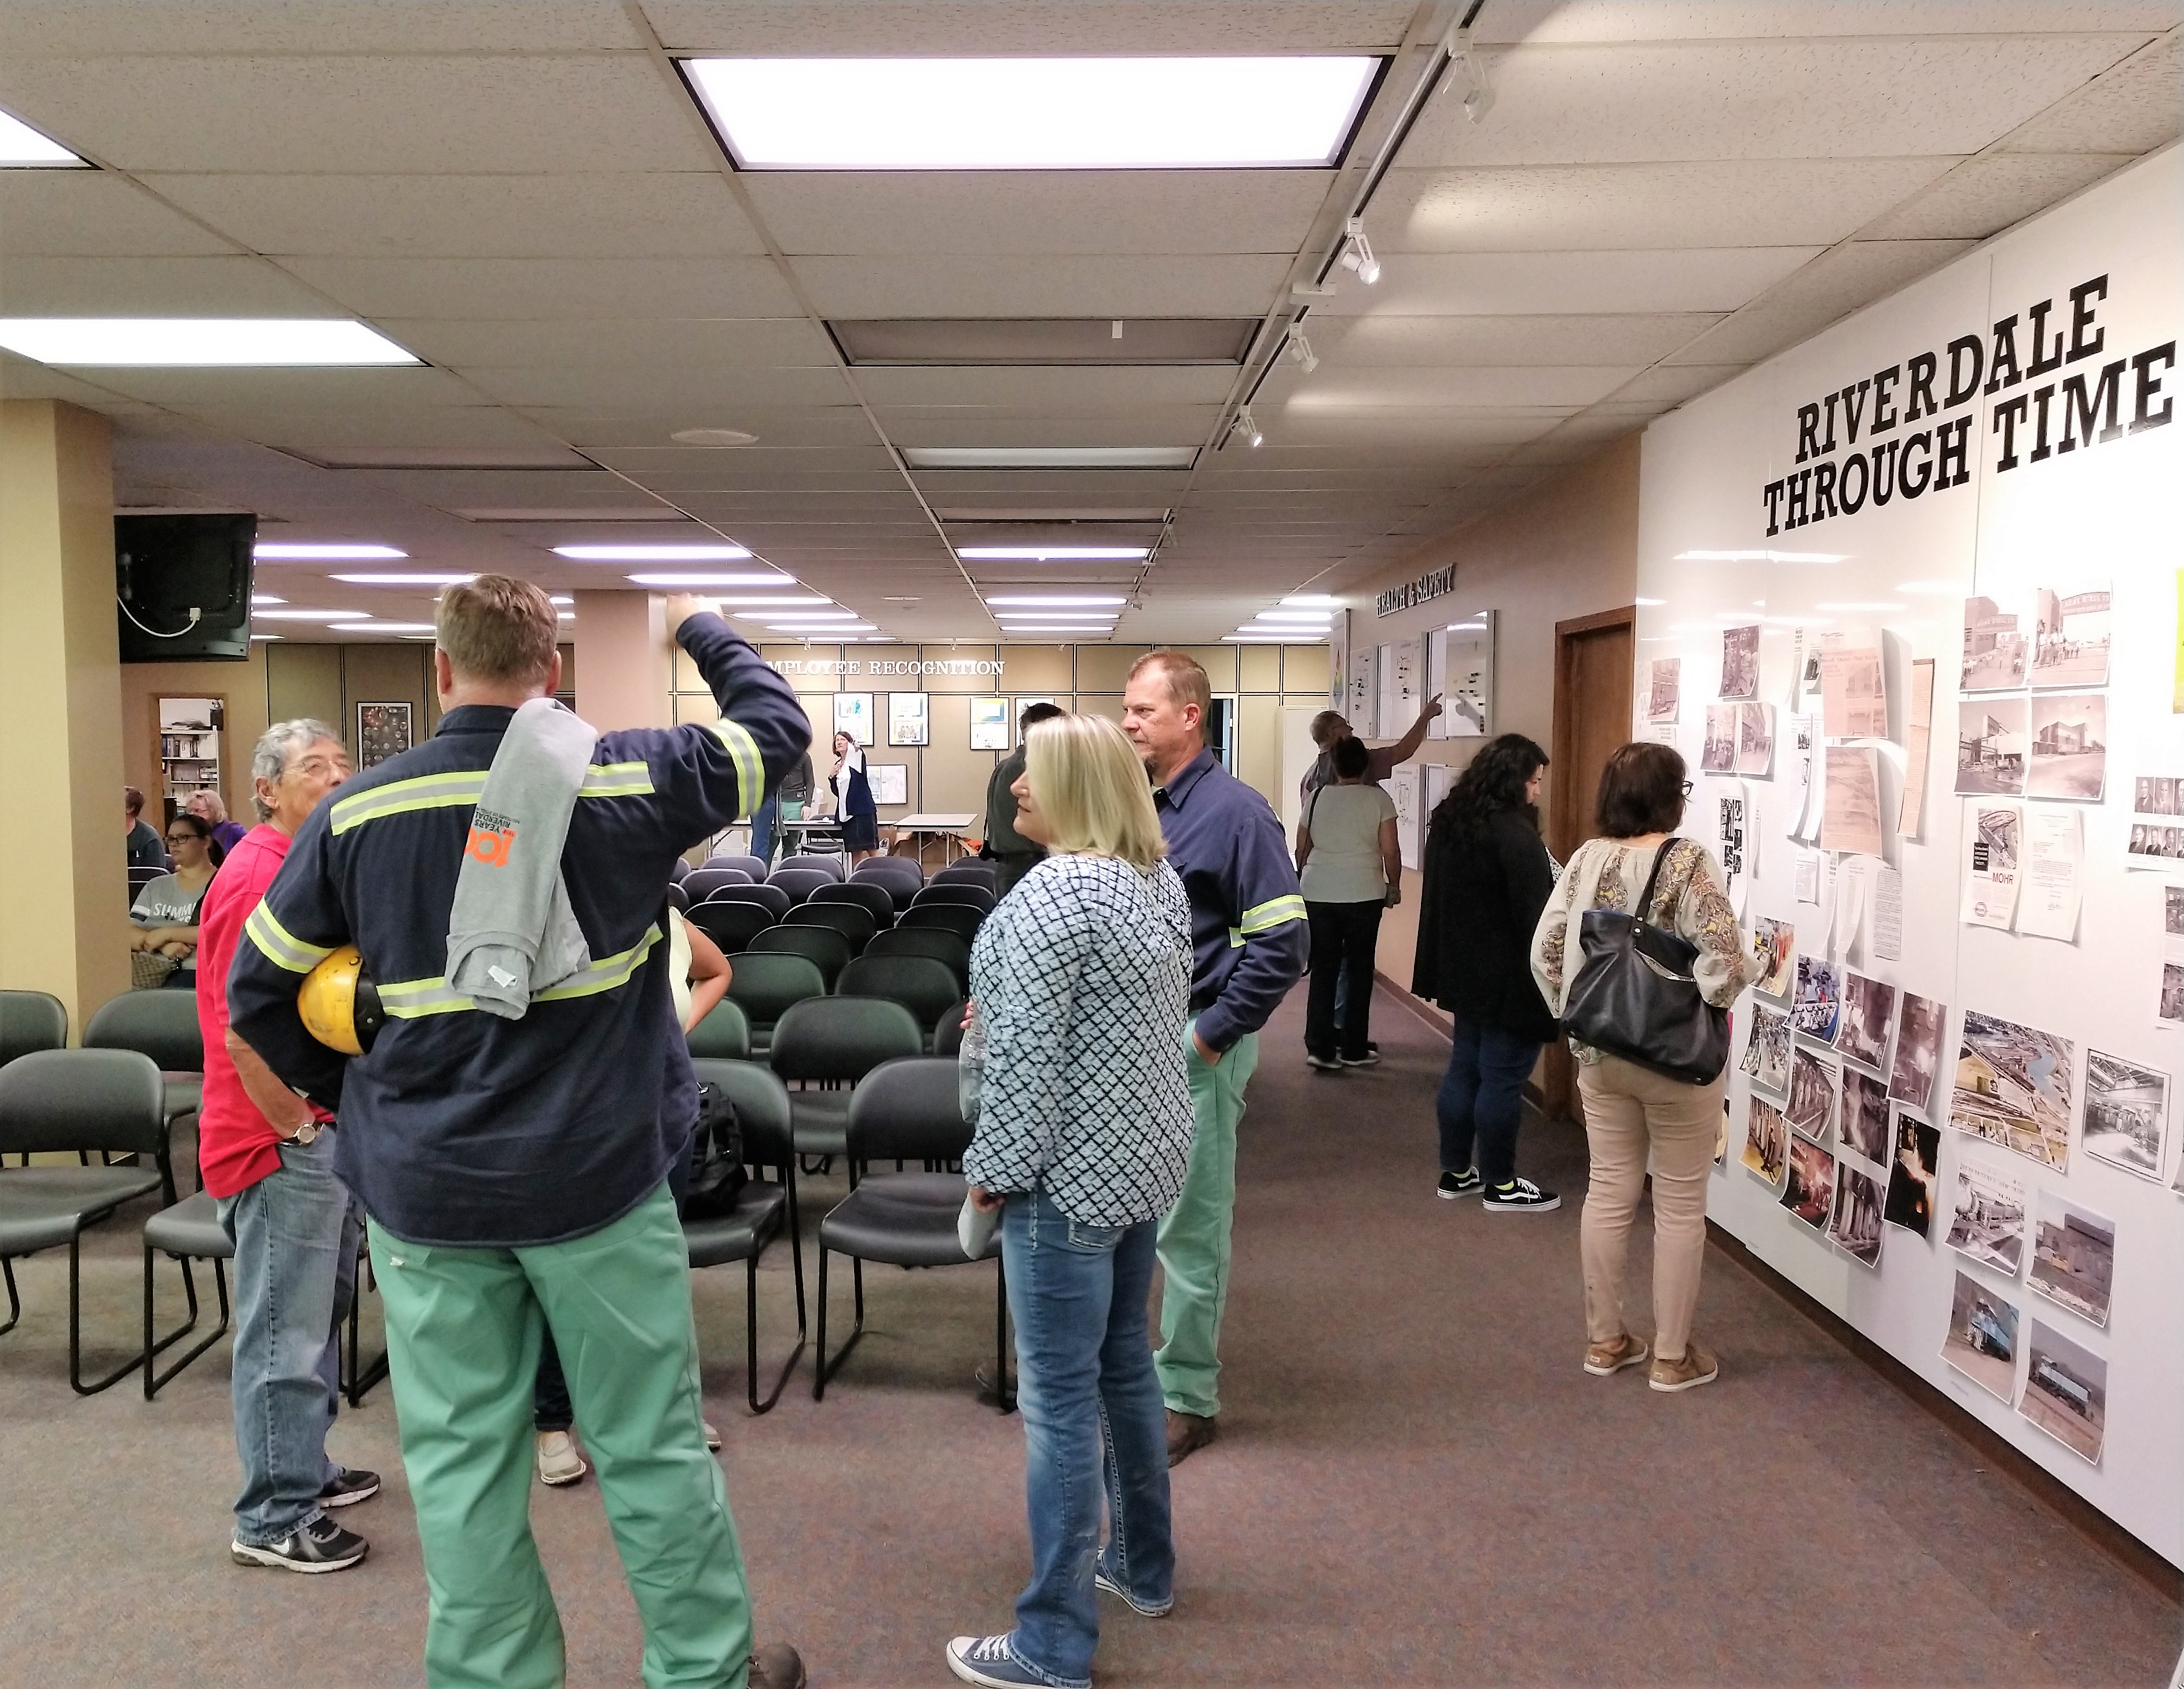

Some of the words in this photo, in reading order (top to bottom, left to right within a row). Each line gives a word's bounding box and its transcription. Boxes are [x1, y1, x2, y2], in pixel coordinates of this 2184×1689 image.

[1795, 273, 2109, 464] RIVERDALE
[1763, 415, 1973, 538] THROUGH
[1992, 340, 2177, 474] TIME
[1375, 584, 1407, 618] HEALTH
[1408, 582, 1416, 606] &
[1417, 563, 1455, 604] SAFETY
[765, 660, 861, 675] MPLOYEE
[868, 660, 1006, 676] RECOGNITION
[474, 819, 500, 833] YEARS
[1992, 872, 2014, 885] MOHR
